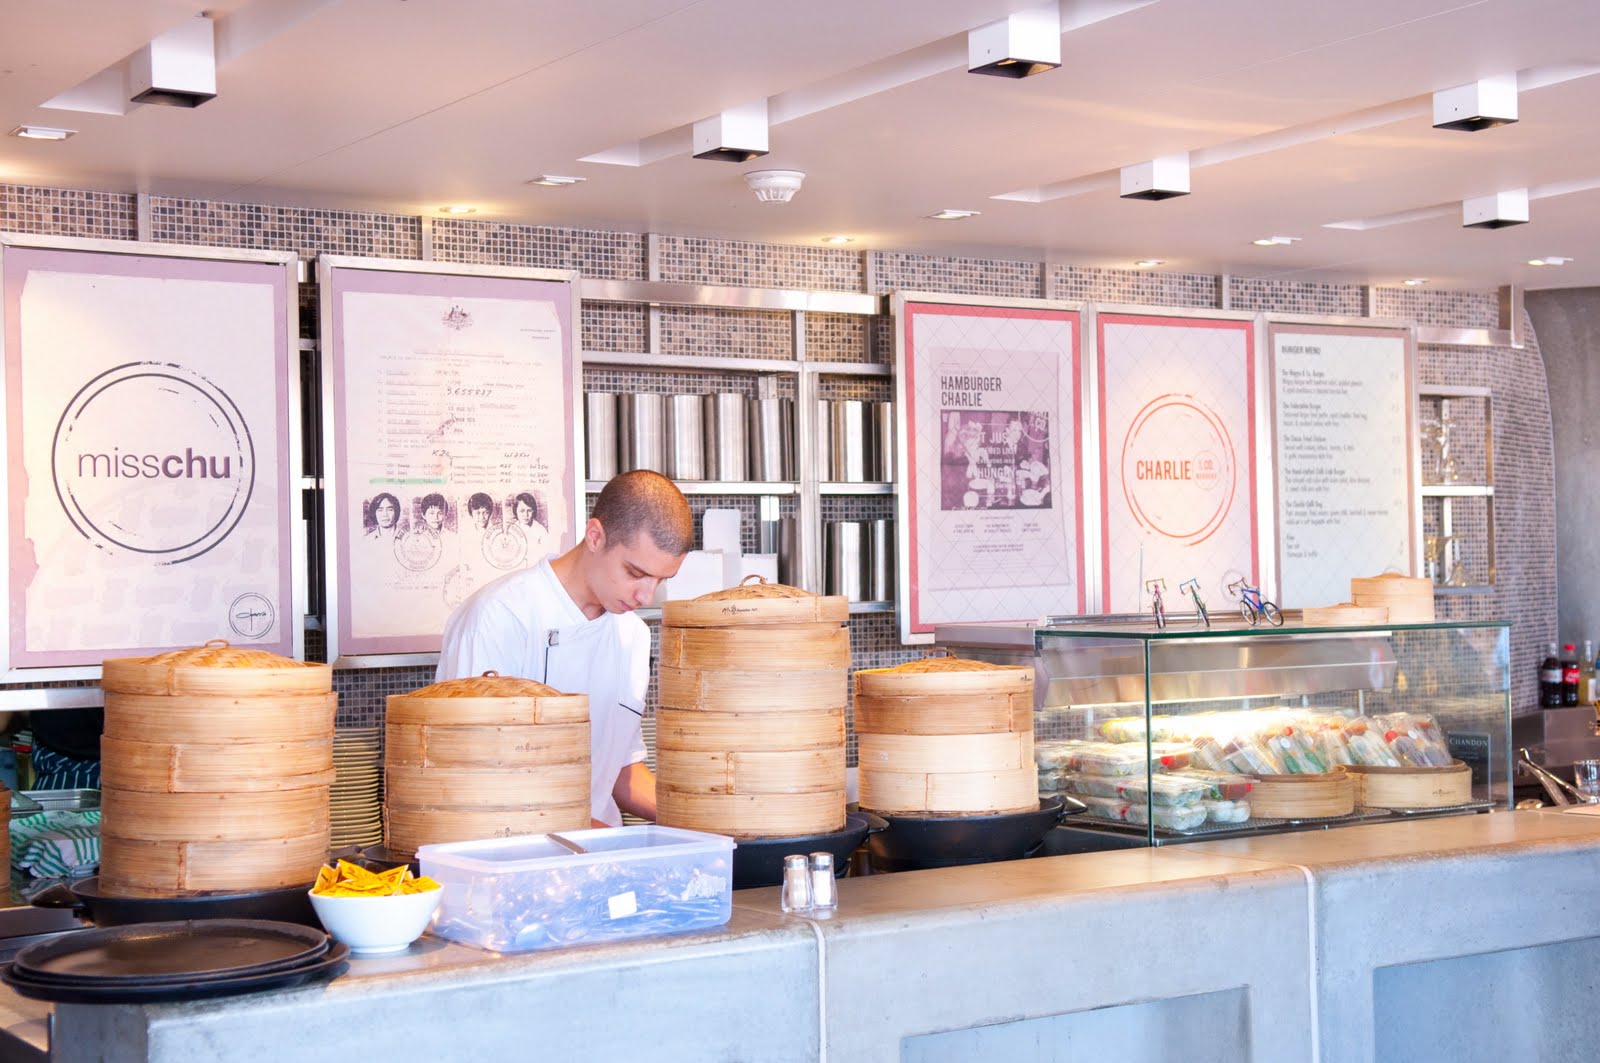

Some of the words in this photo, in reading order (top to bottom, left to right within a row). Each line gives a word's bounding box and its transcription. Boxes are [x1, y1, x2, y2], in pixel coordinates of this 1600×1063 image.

[941, 376, 1002, 391] HAMBURGER
[941, 392, 982, 406] CHARLIE
[78, 447, 231, 479] misschu
[1136, 460, 1191, 480] CHARLIE
[1450, 738, 1488, 746] CHANDON
